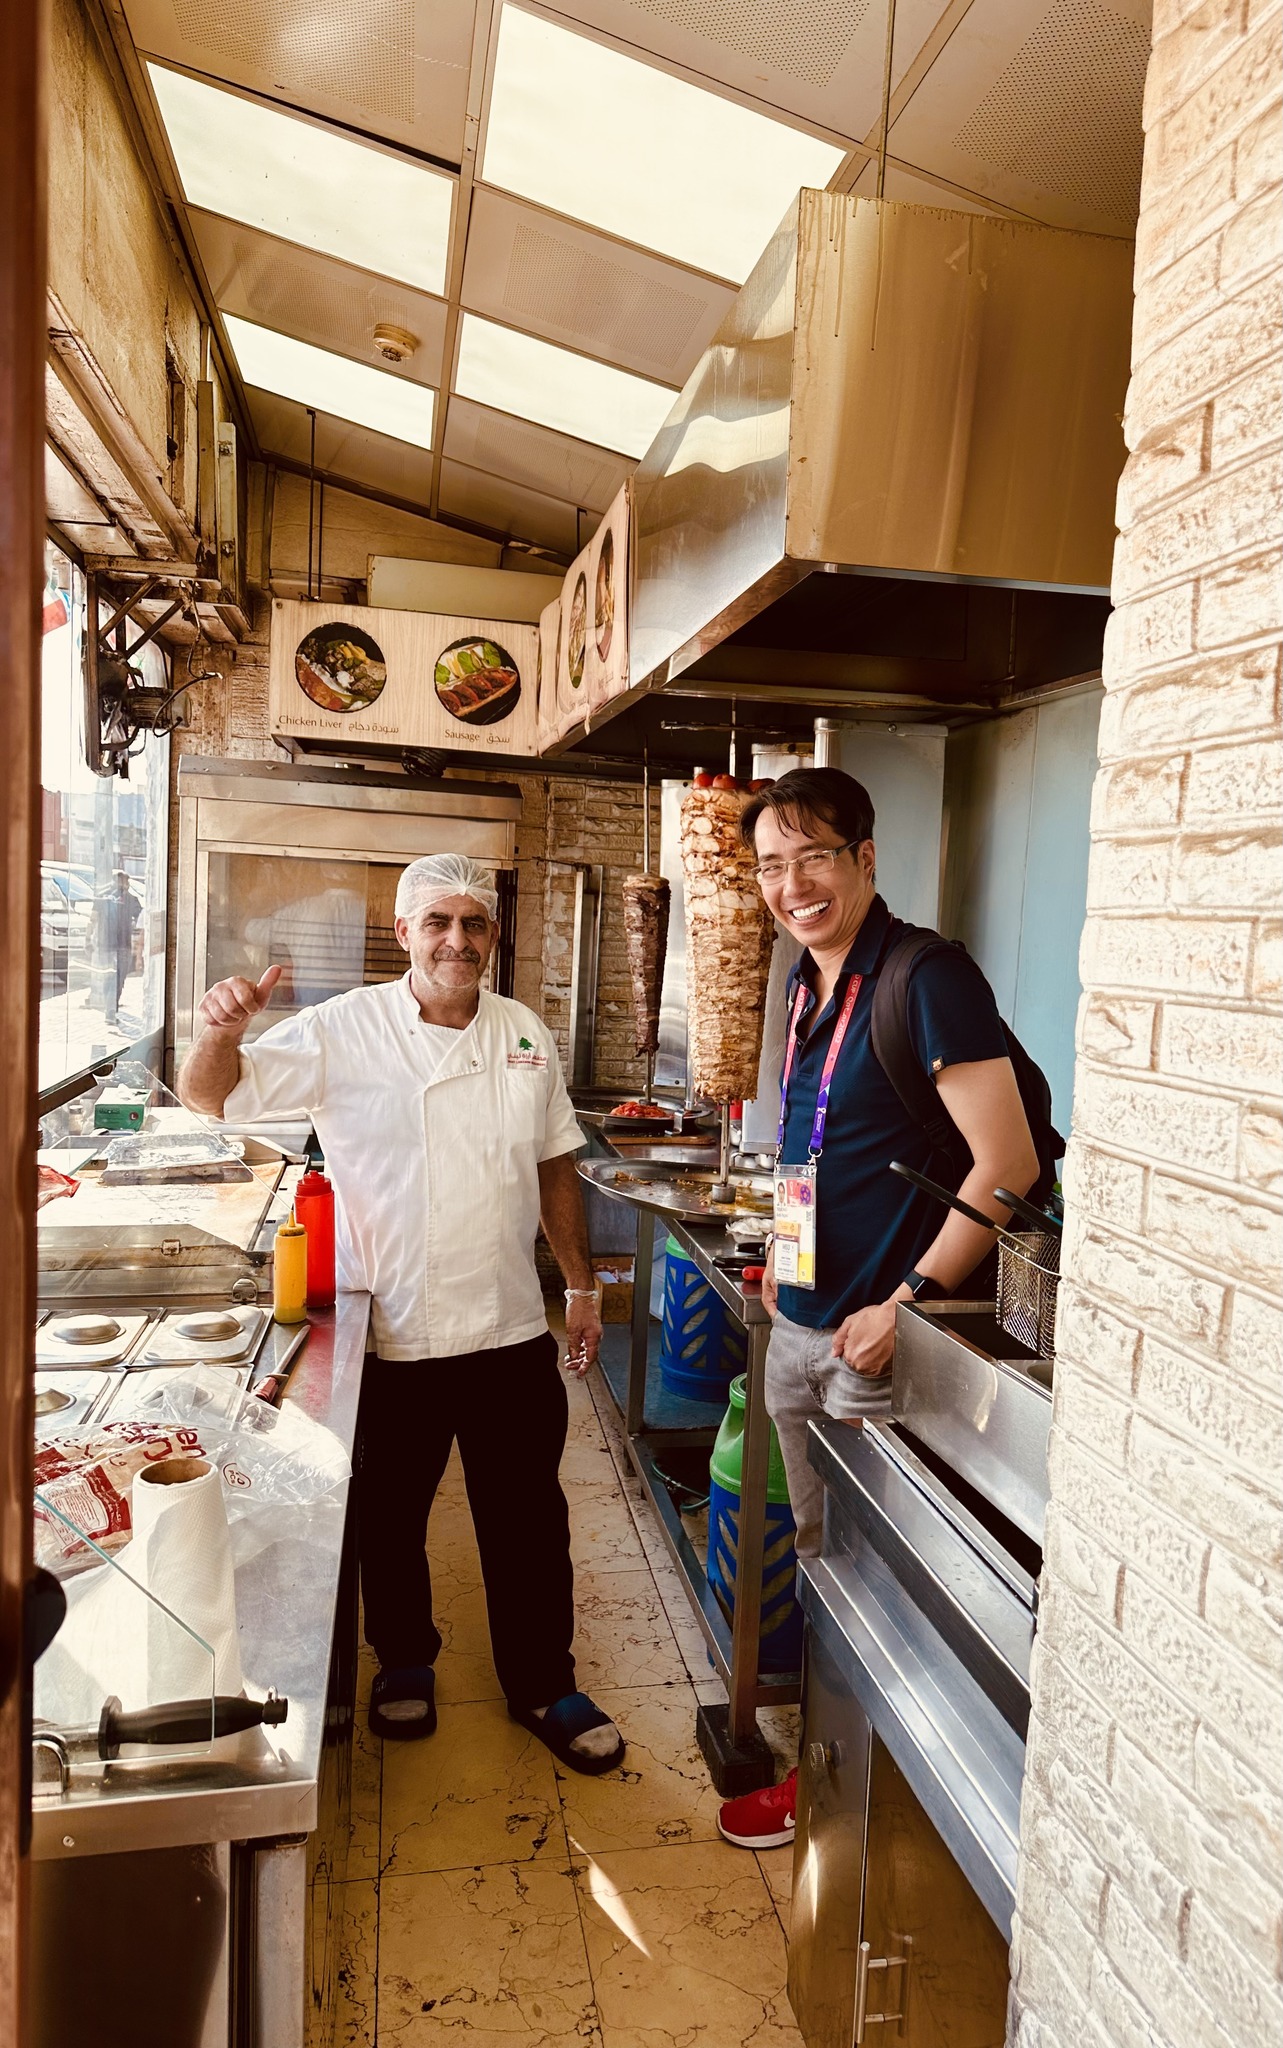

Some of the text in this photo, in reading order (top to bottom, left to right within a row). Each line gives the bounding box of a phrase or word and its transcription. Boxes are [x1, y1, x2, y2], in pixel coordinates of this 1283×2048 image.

[278, 714, 342, 729] Chicken Liver
[444, 729, 480, 742] Sausage
[486, 732, 510, 745] سجق
